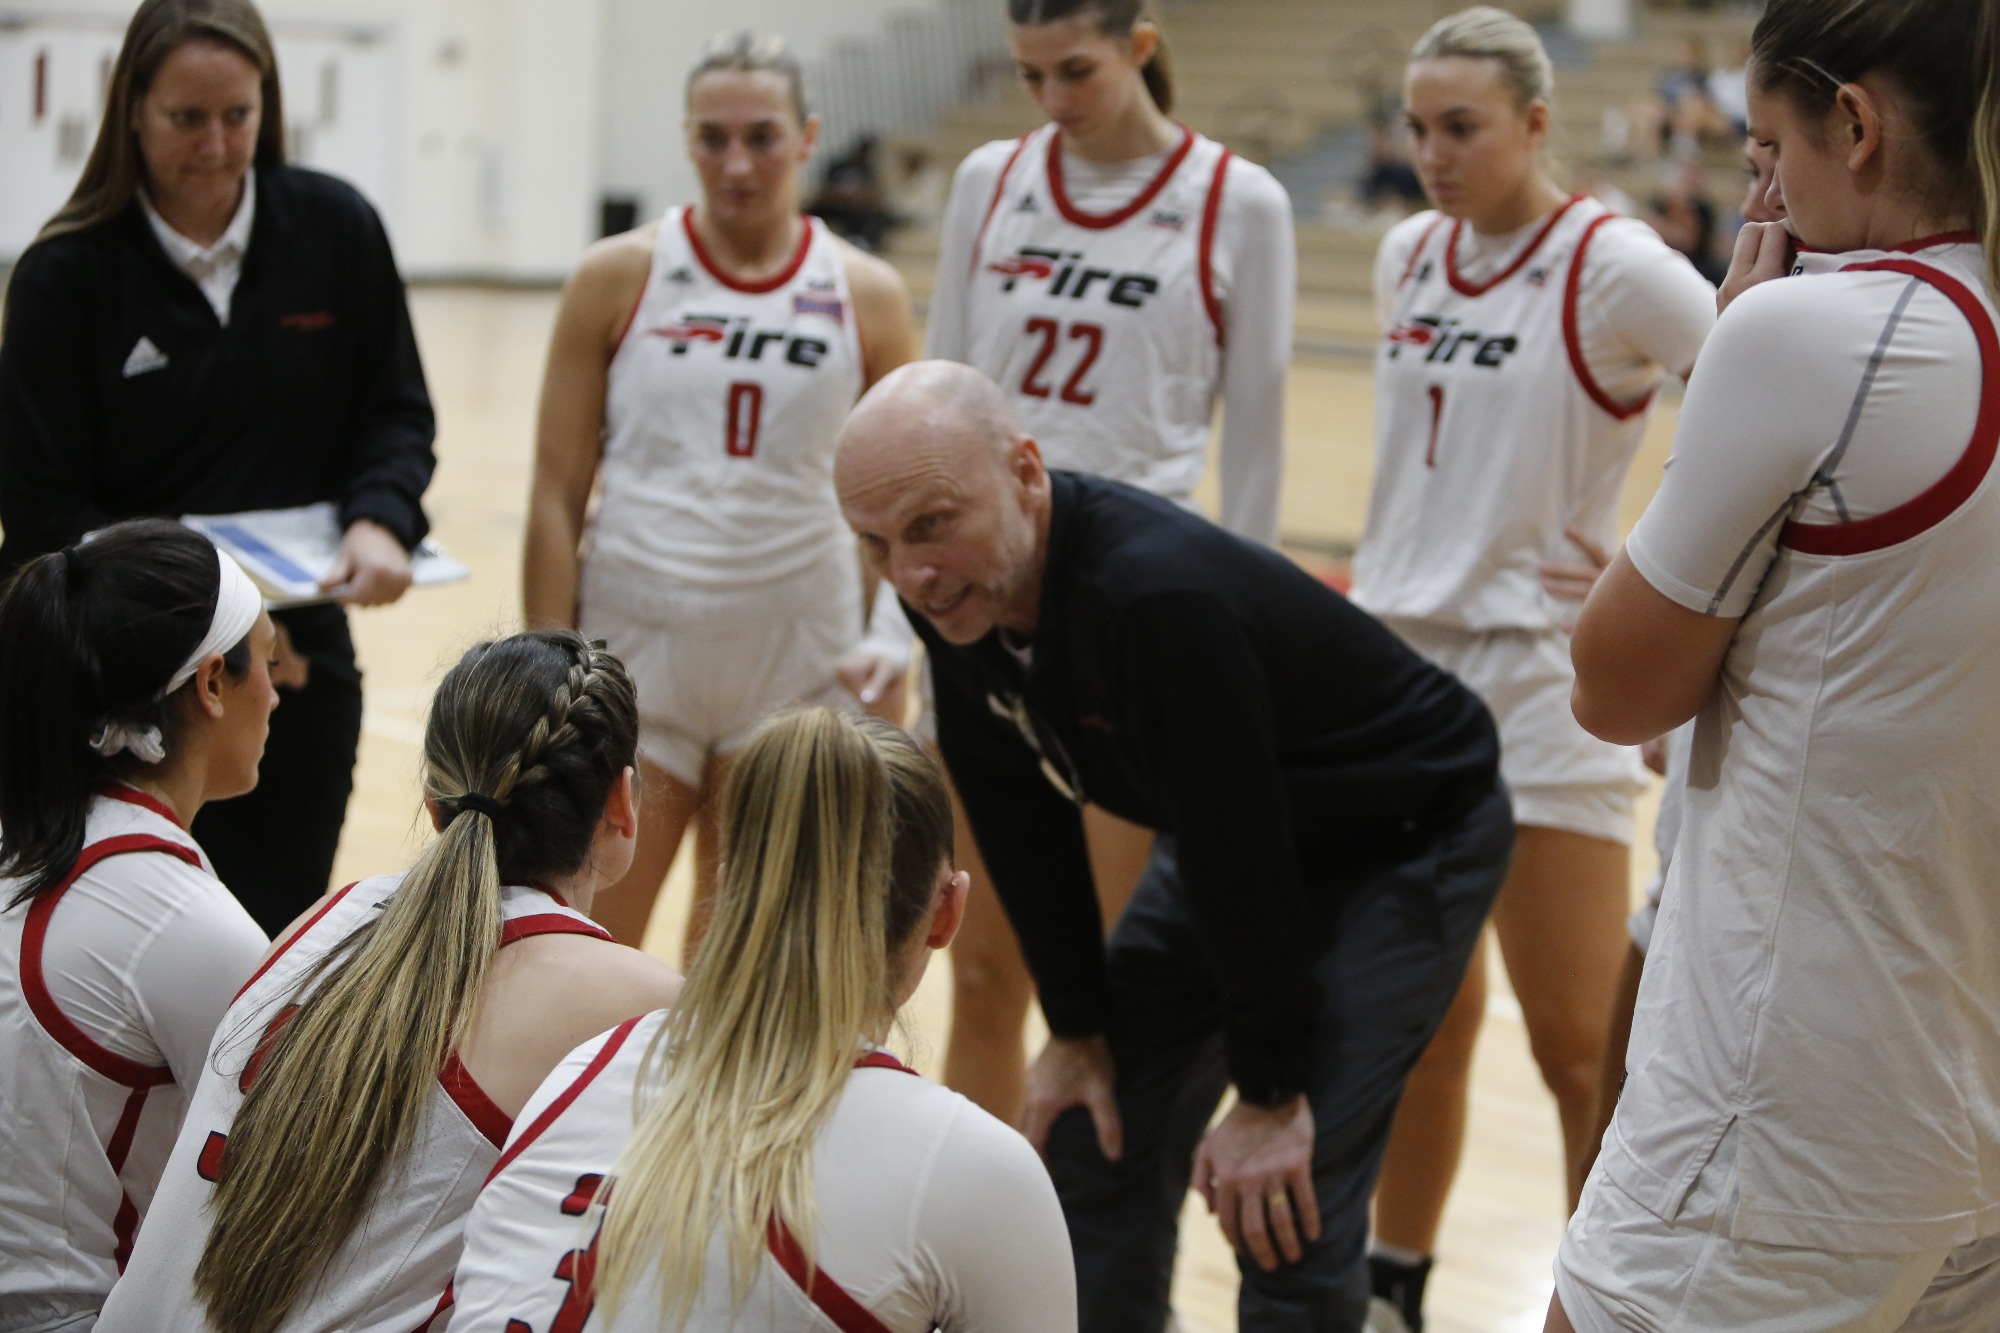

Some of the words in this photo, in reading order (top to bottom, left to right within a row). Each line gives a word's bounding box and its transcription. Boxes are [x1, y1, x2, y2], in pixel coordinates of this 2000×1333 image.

[984, 247, 1160, 308] Fire
[652, 313, 829, 368] Fire
[1021, 316, 1103, 406] 22
[1386, 315, 1519, 367] Fire
[725, 381, 762, 458] 0
[1425, 384, 1444, 469] 1
